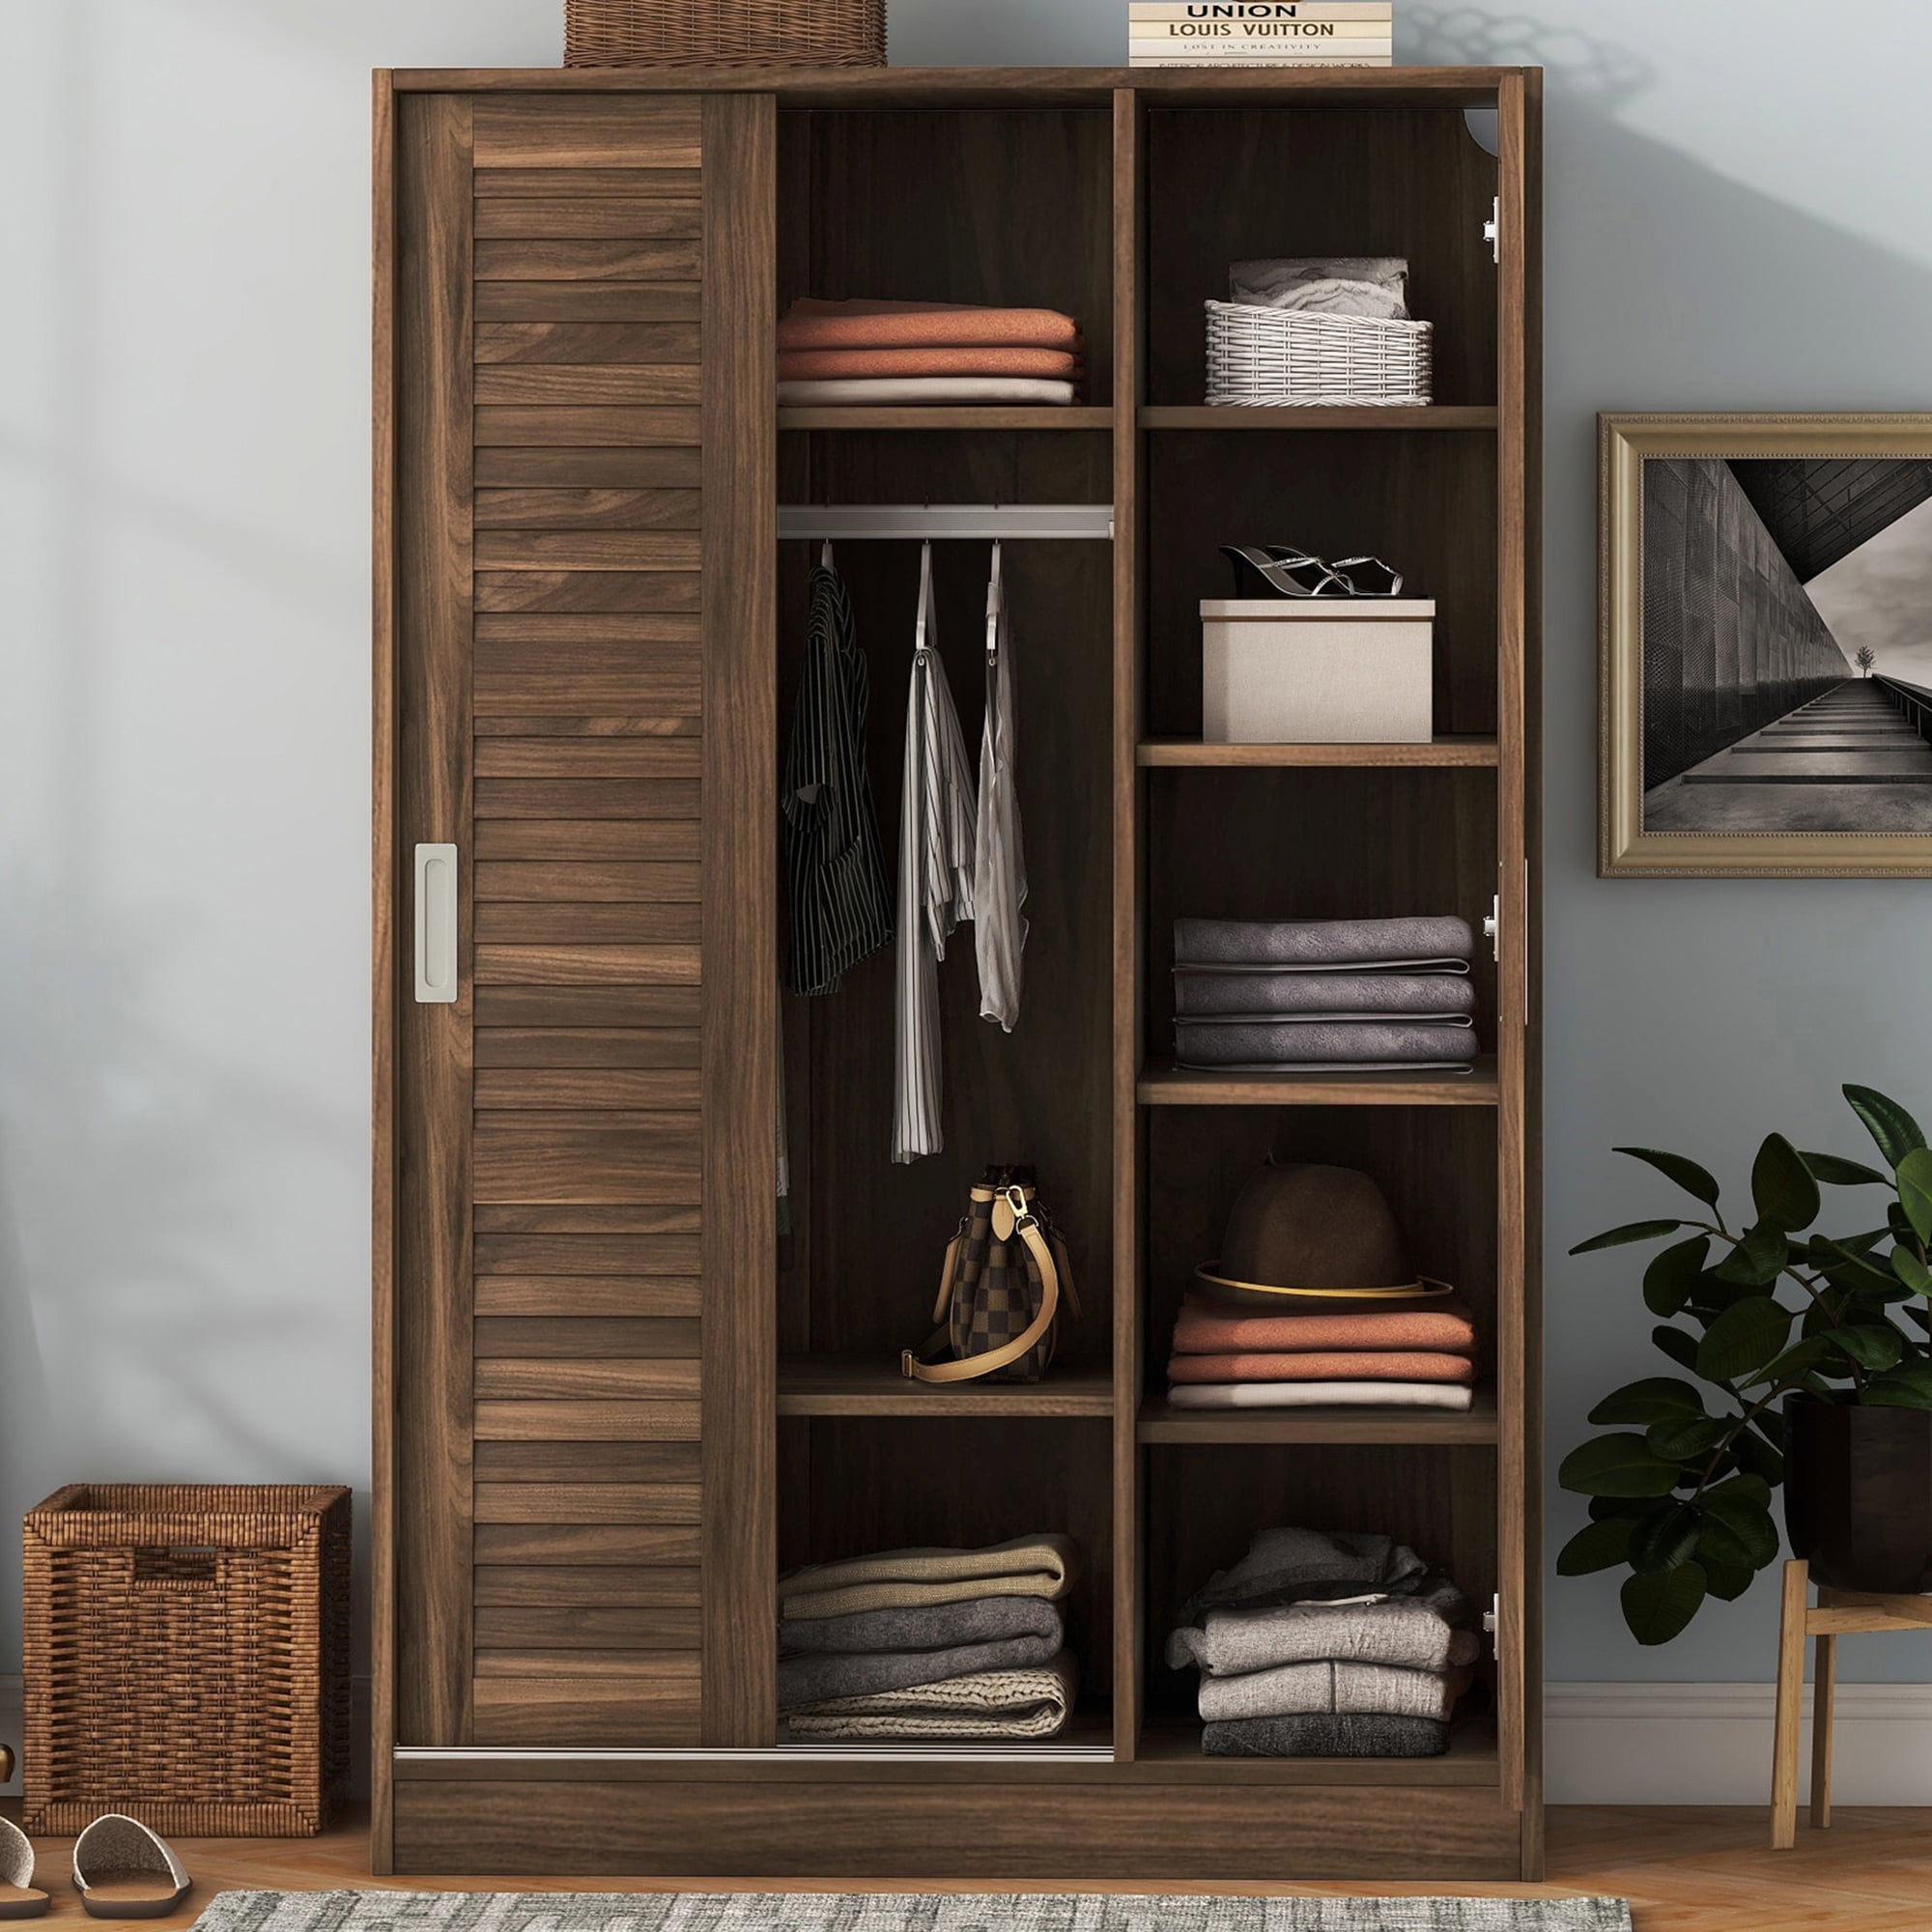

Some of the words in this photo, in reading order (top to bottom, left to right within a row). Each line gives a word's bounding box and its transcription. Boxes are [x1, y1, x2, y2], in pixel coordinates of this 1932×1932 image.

[1187, 5, 1296, 17] UNION
[1170, 23, 1232, 37] LOUIS
[1242, 23, 1334, 37] VUITTON
